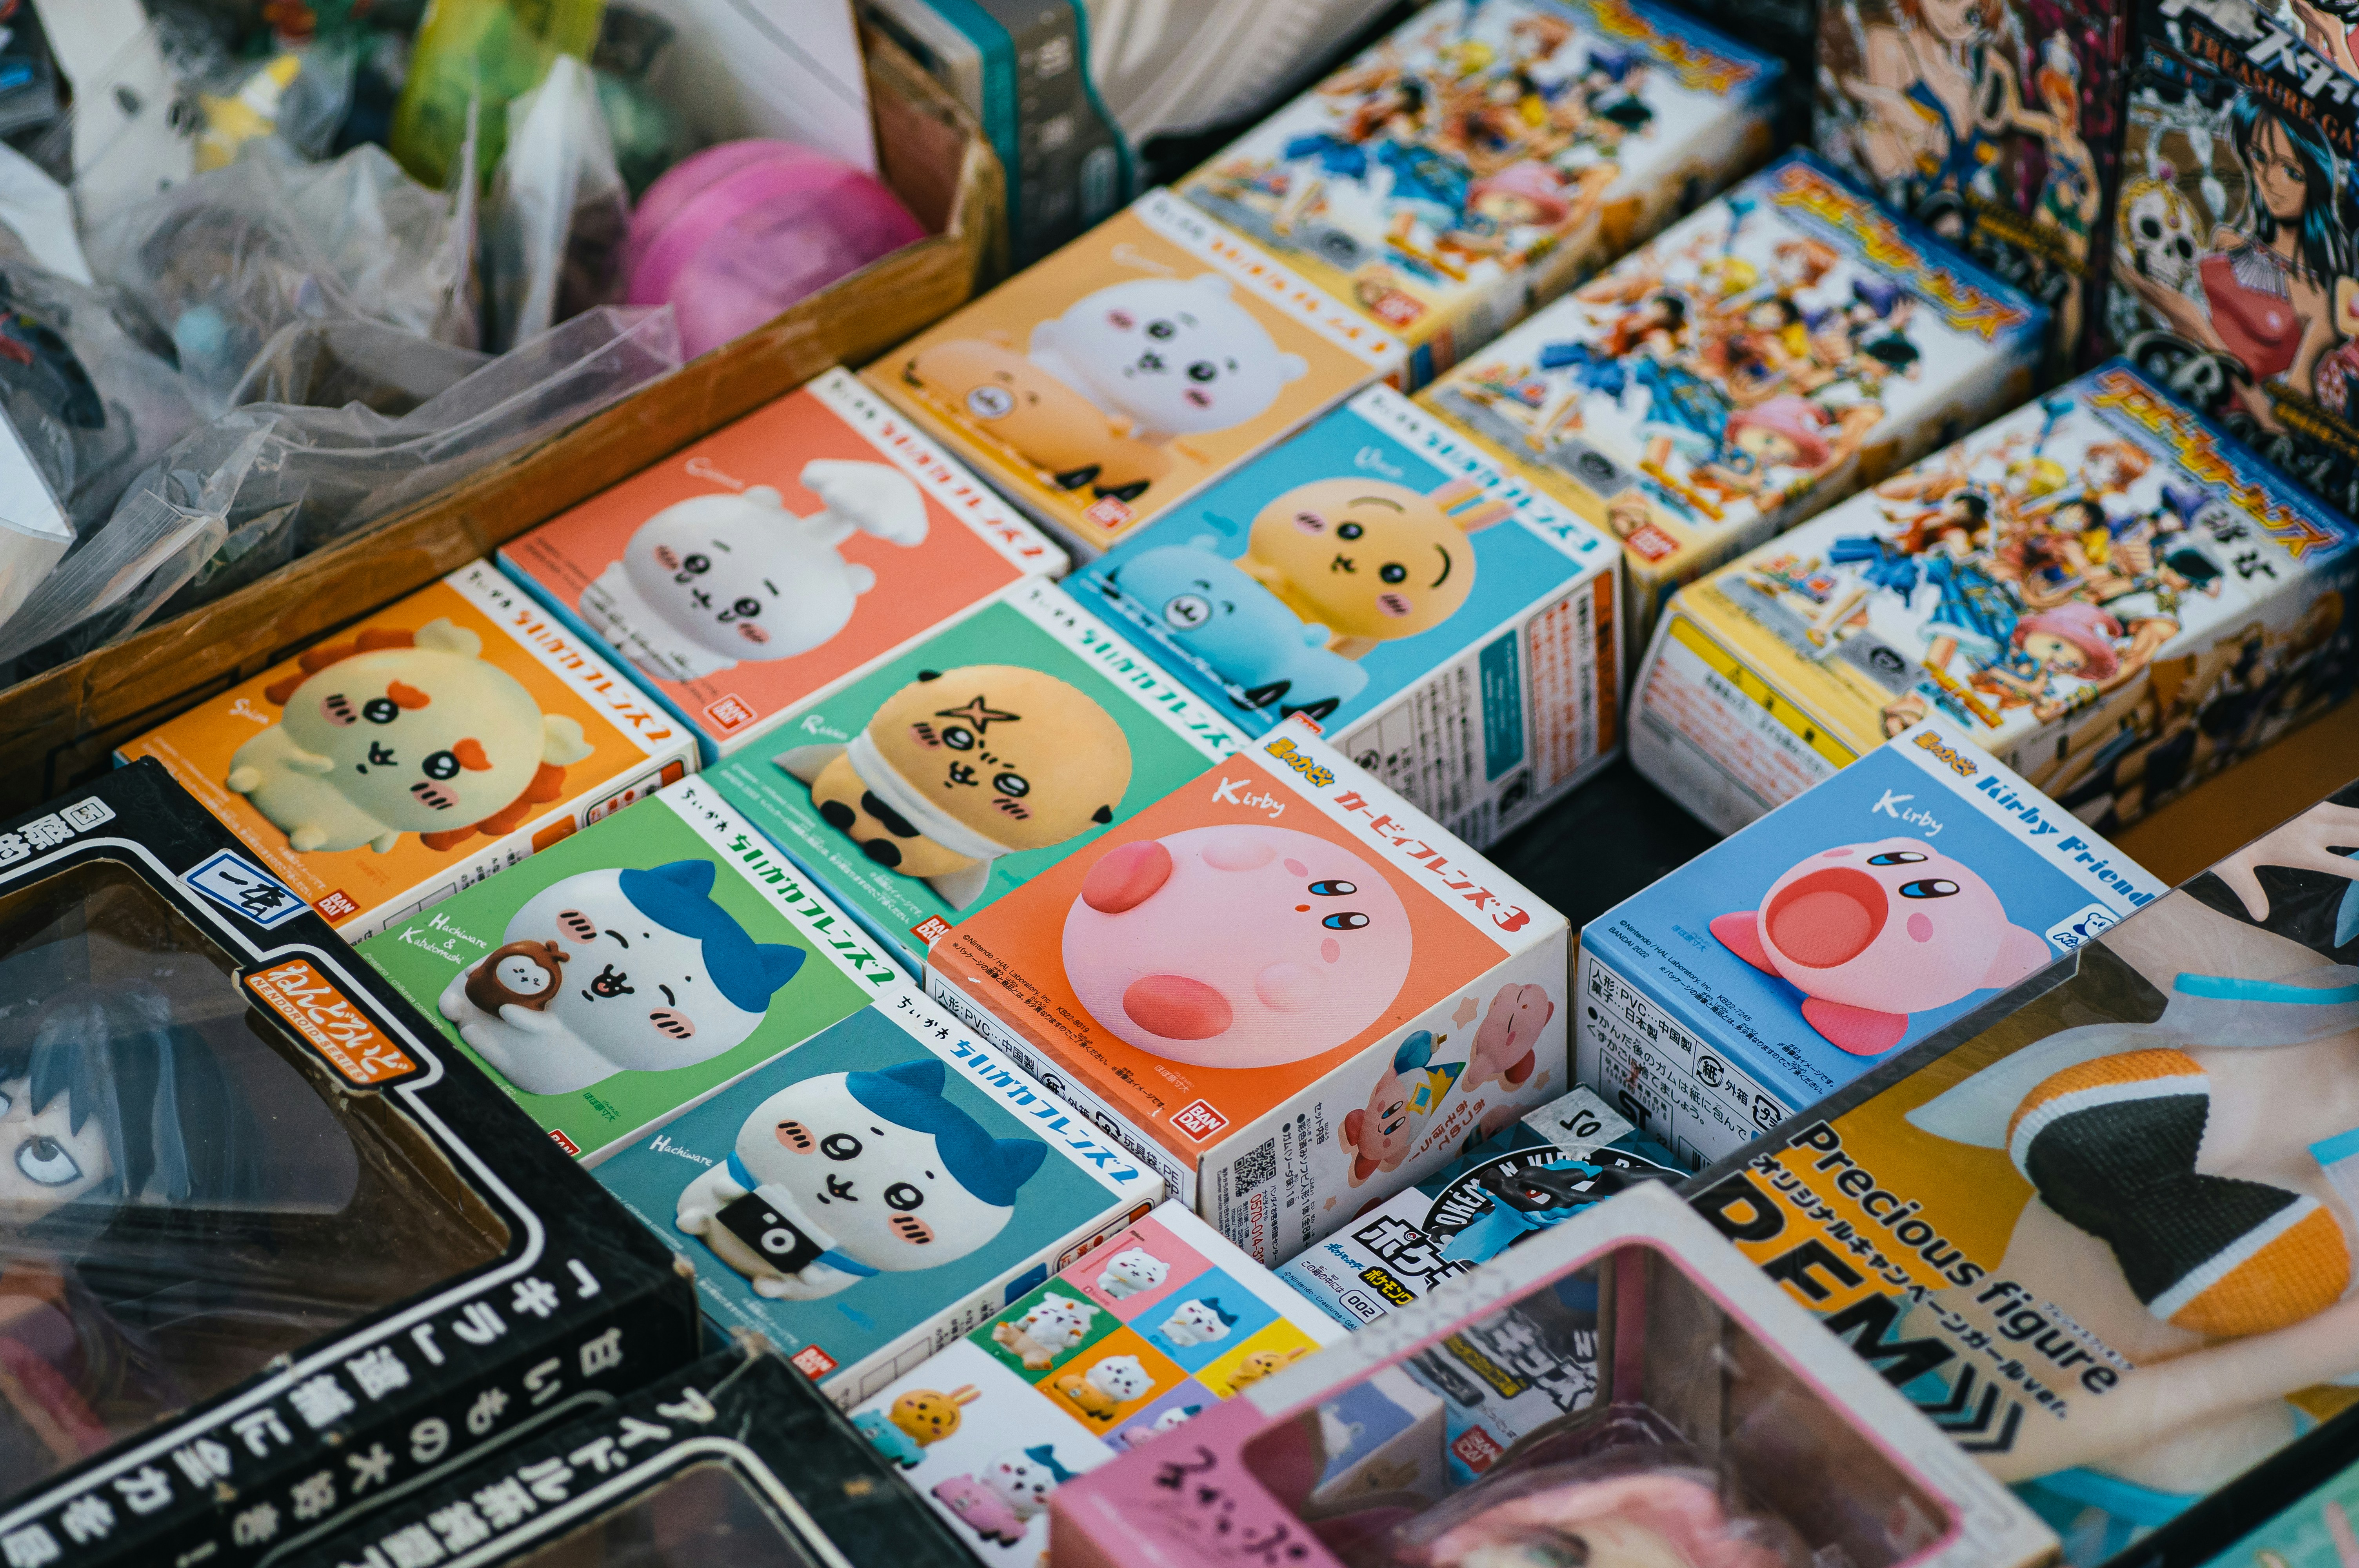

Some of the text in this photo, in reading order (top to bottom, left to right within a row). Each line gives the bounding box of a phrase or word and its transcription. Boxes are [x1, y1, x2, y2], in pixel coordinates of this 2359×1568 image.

[1263, 736, 1335, 790] 星のカービィ
[1912, 730, 1978, 779] 星のカービィ
[1212, 777, 1285, 818] Kirby
[1871, 788, 1944, 837] Kirby
[1976, 775, 2059, 836] Kirby
[318, 899, 340, 916] DAI
[329, 892, 355, 914] BAN
[681, 787, 728, 833] ちいかわ
[727, 833, 895, 987] ちいかわフレンズ2
[398, 926, 465, 965] Kabutomushi
[429, 912, 487, 949] Hachiware
[443, 938, 454, 949] &
[1608, 926, 1650, 959] BANDAI 2022
[962, 933, 1090, 1033] ©Nintendo HAL Laboratory, Inc. KB22-8019
[1619, 919, 1752, 1022] ©Nintendo HAL Laboratory, Inc. KB22-7245
[251, 977, 369, 1083] NENDOROID-SERIES
[268, 965, 409, 1075] ねんどろいど
[898, 996, 1138, 1185] ちいかわ ちいかわフレンズ2
[1154, 1064, 1190, 1094] ほぼ原寸大
[1702, 1059, 1748, 1106] 紙 外箱
[1176, 1116, 1201, 1133] DAI
[1189, 1107, 1220, 1130] BAN
[1314, 1102, 1325, 1145] セット内容
[1618, 1089, 1652, 1132] ST
[649, 1134, 713, 1167] Hachiware
[1301, 1260, 1344, 1294] この箱の中には
[1788, 1120, 2119, 1394] Precious figure
[1285, 1271, 1313, 1295] ©Nintendo
[1316, 1296, 1343, 1319] Creatures
[1345, 1320, 1361, 1332] GAM
[1347, 1296, 1375, 1318] 002
